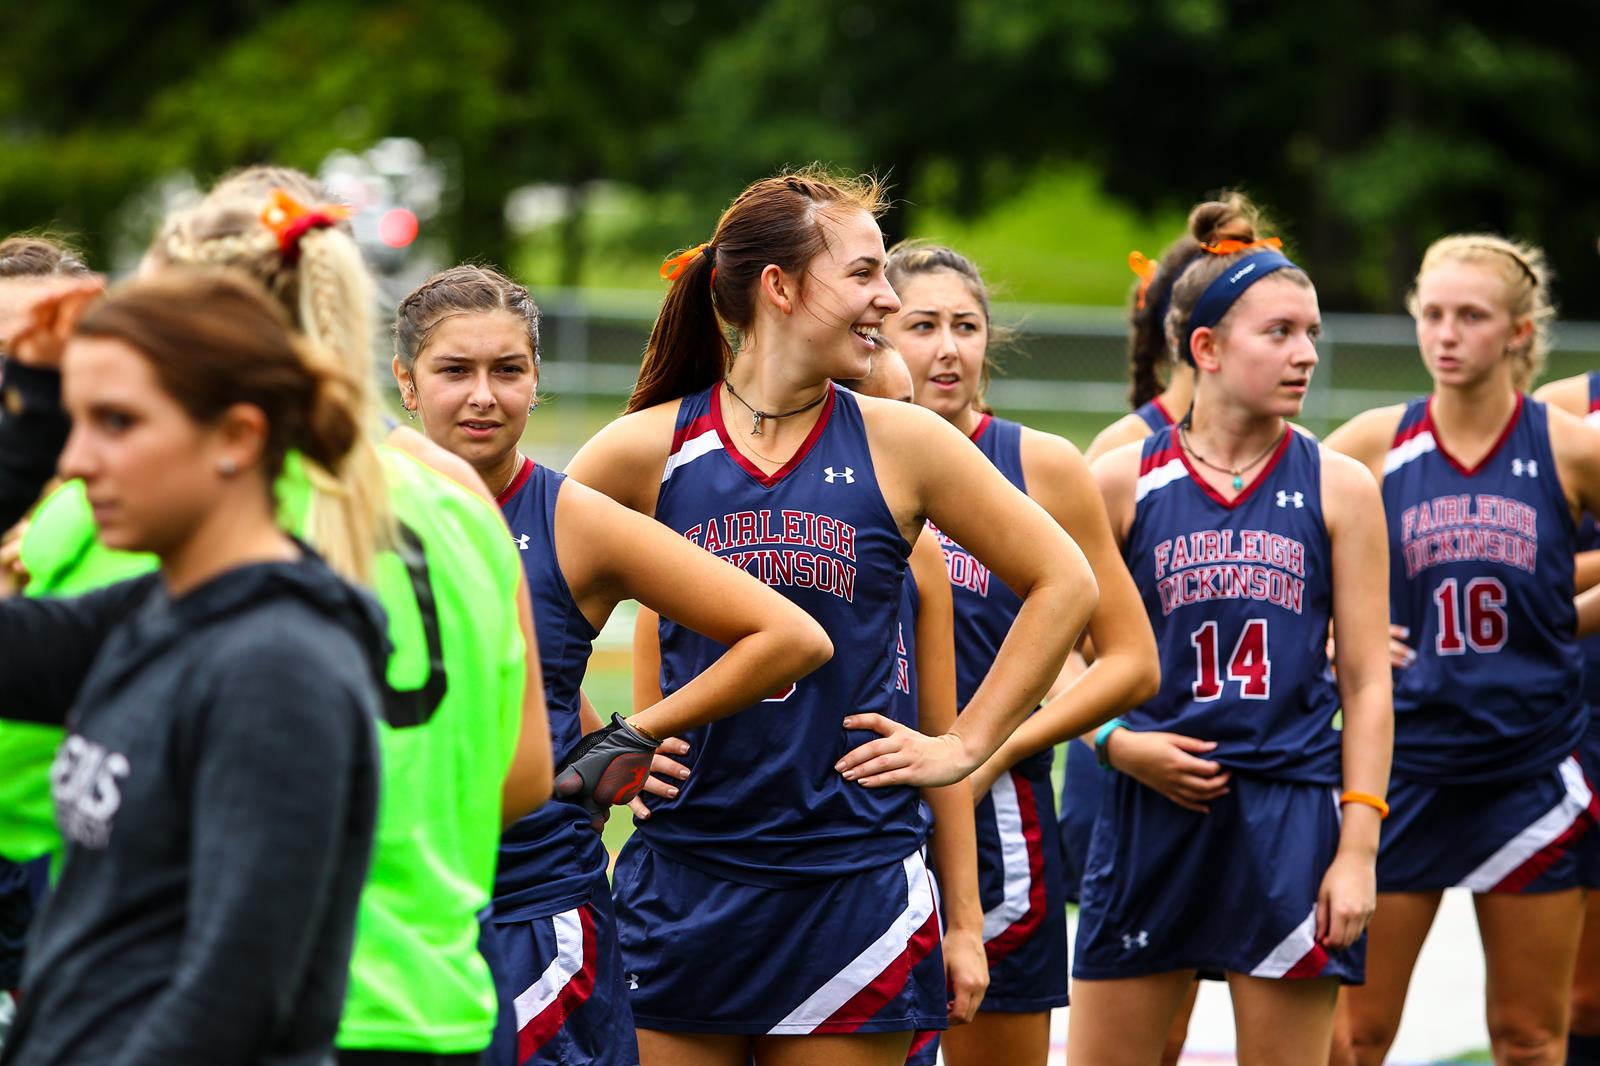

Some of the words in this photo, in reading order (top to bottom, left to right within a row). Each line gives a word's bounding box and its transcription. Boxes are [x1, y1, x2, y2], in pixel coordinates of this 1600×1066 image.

[1402, 494, 1537, 543] FAIRLEIGH
[721, 550, 856, 603] KINSON
[1154, 529, 1305, 580] FAIRLEIGH
[1402, 527, 1538, 579] DICKINSON
[1157, 565, 1305, 616] DICKINSON
[1433, 577, 1508, 656] 16
[1191, 618, 1271, 702] 14
